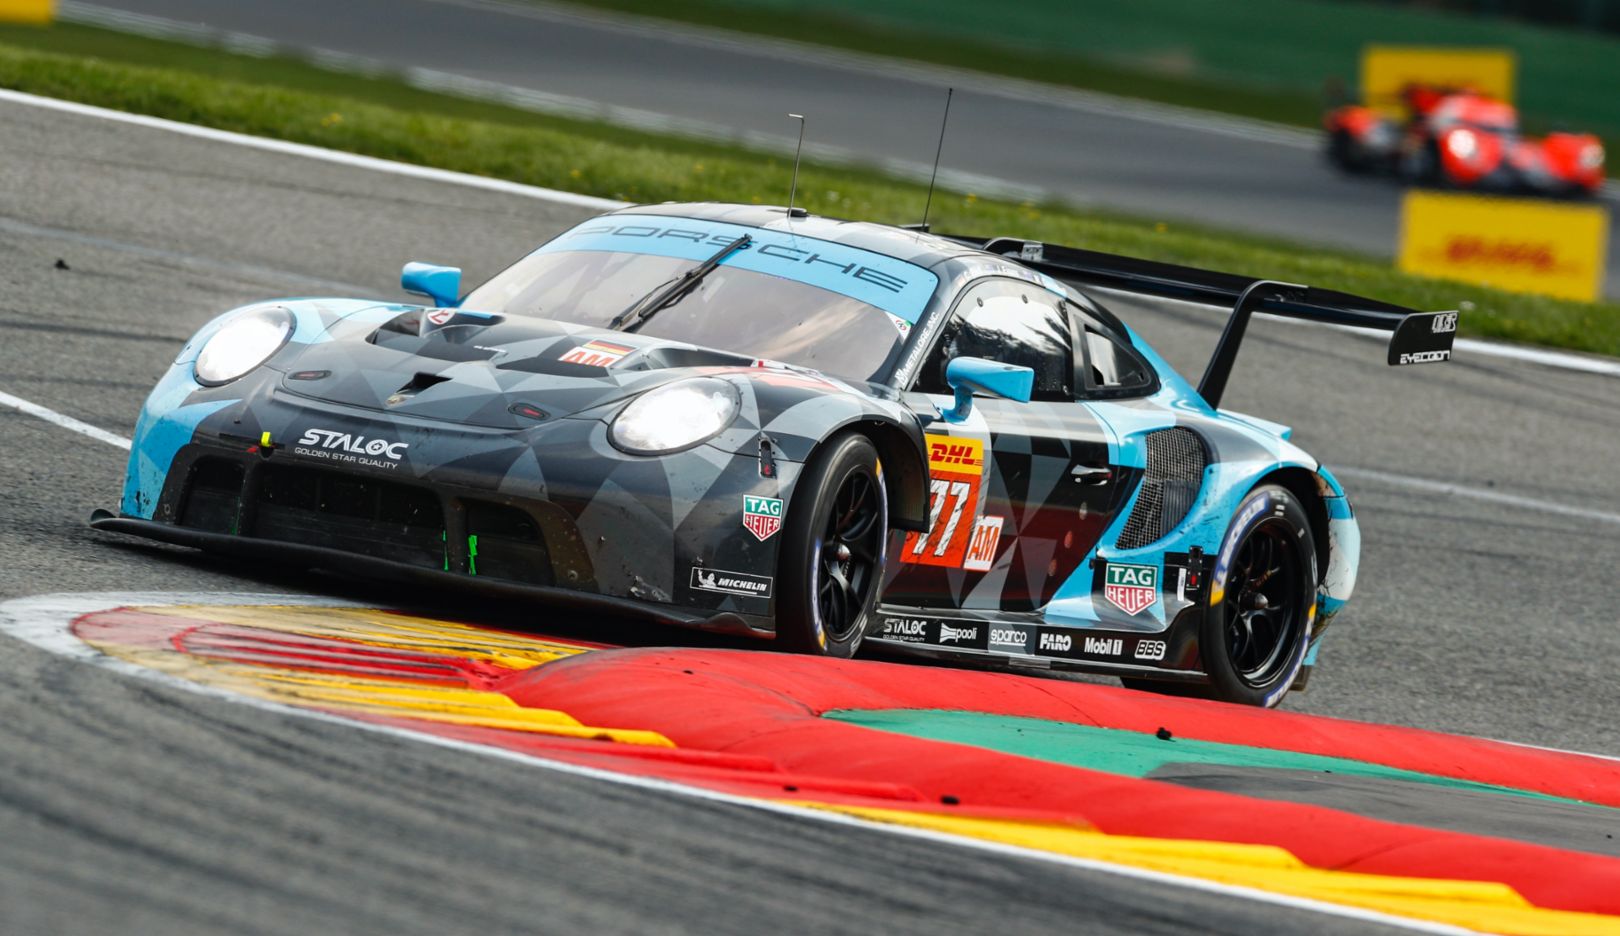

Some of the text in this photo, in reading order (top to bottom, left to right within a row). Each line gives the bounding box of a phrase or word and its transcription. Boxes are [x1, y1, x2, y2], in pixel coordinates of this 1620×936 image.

[568, 226, 908, 294] PORSCHE
[563, 351, 616, 368] AM
[298, 428, 409, 460] STALOC
[294, 447, 398, 470] GOLDEN STAR QUALITY
[930, 443, 975, 465] DHL
[747, 498, 780, 515] TAG
[745, 514, 779, 538] HEUER
[968, 525, 999, 562] AM
[718, 578, 767, 591] MICHELIN
[1110, 567, 1153, 586] TAG
[1108, 587, 1153, 612] HEUER
[883, 618, 927, 635] STALOC
[990, 629, 1027, 645] sparco
[1040, 633, 1072, 651] FARO
[1084, 637, 1112, 654] Mobil
[1135, 641, 1166, 659] BBS
